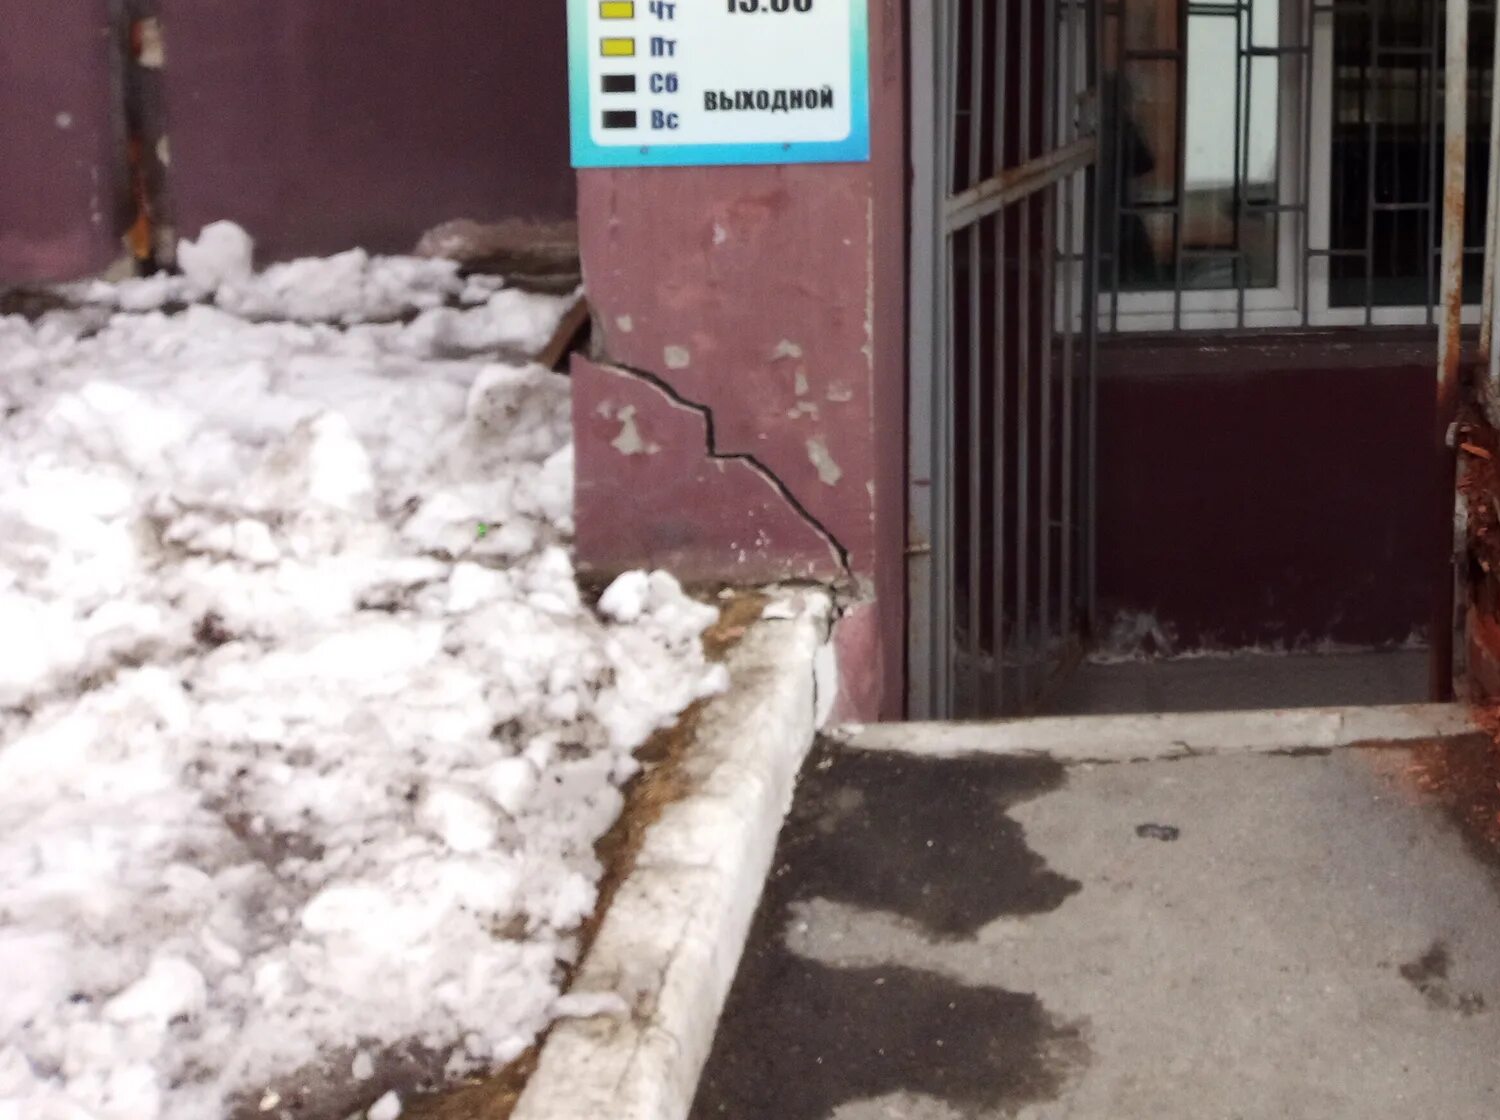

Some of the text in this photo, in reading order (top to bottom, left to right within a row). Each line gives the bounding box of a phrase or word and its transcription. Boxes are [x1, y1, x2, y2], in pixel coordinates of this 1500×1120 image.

[648, 0, 677, 21] Чт
[649, 37, 677, 58] Пт
[649, 72, 679, 93] Сб
[651, 109, 680, 130] Вс
